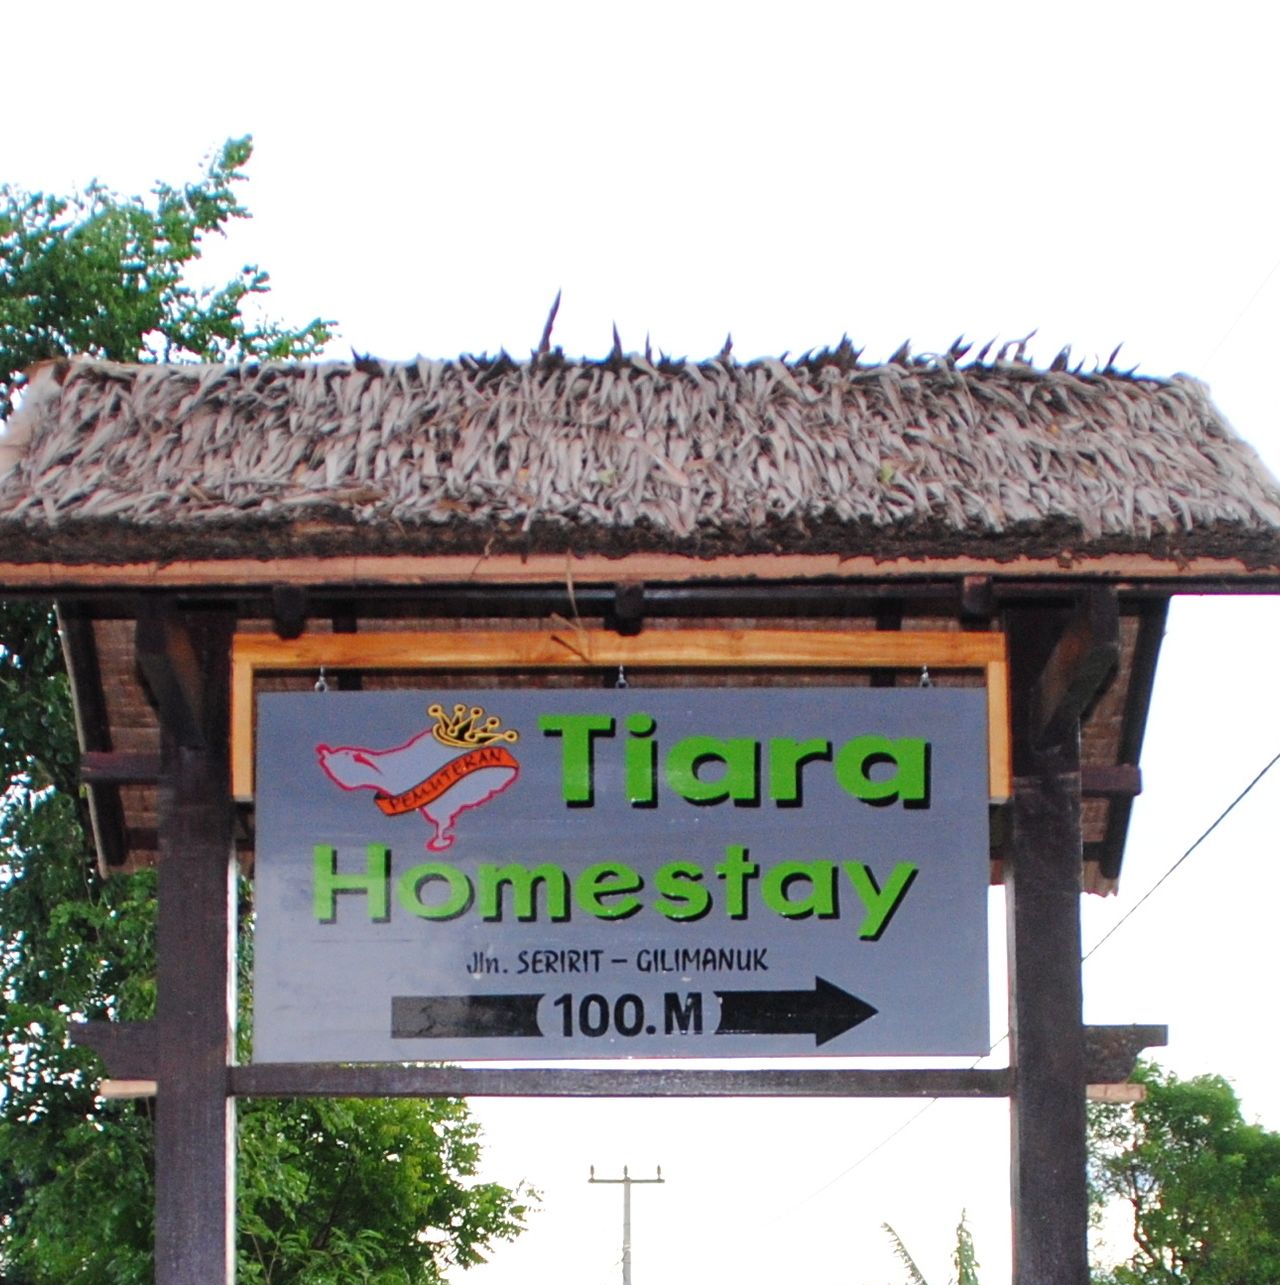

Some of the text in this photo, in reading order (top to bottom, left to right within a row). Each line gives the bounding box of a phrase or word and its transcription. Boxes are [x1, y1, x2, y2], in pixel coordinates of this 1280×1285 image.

[537, 713, 930, 808] Tiara
[312, 843, 919, 940] Homestay
[466, 951, 508, 974] Jln.
[517, 949, 604, 974] SERIRIT
[636, 947, 769, 972] GILIMANUK
